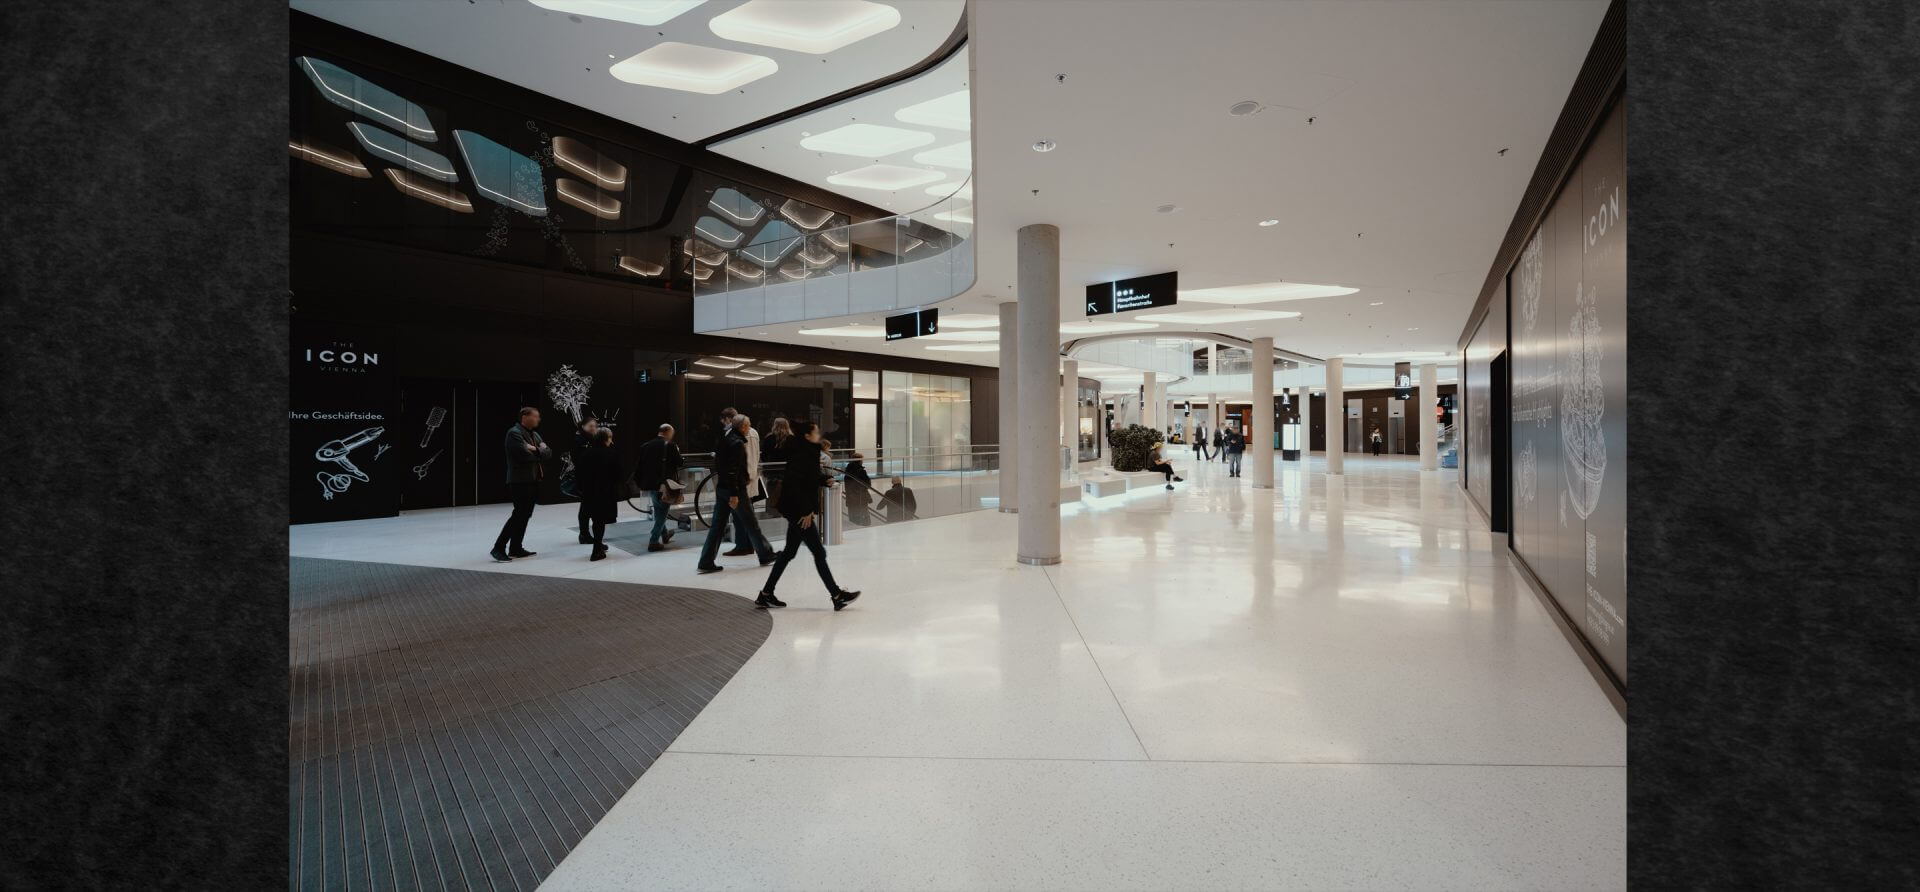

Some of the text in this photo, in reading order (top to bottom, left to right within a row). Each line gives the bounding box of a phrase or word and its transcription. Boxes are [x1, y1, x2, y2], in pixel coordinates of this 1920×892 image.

[1584, 186, 1619, 254] ICON
[306, 349, 378, 365] ICON
[288, 411, 385, 420] Ihre Geschäftsidee.
